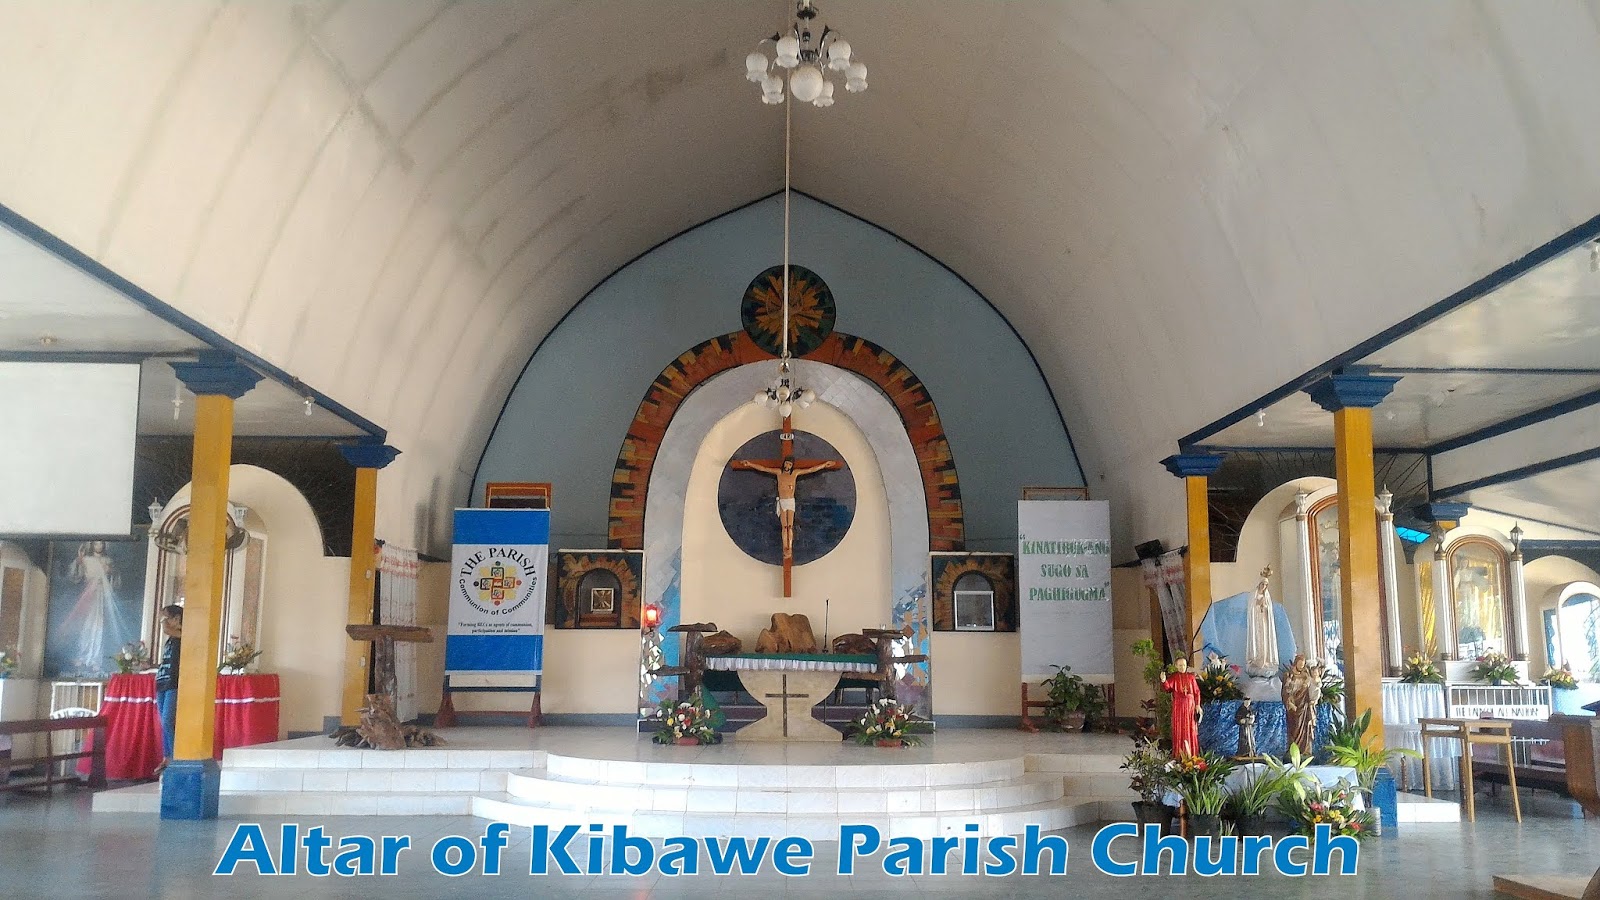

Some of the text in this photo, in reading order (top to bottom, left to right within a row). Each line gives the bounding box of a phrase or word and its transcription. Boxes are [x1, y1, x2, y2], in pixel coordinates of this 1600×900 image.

[460, 547, 536, 576] THE PARISH
[1040, 564, 1089, 578] SUGO SA
[459, 578, 489, 614] Communion
[501, 576, 538, 615] Communities
